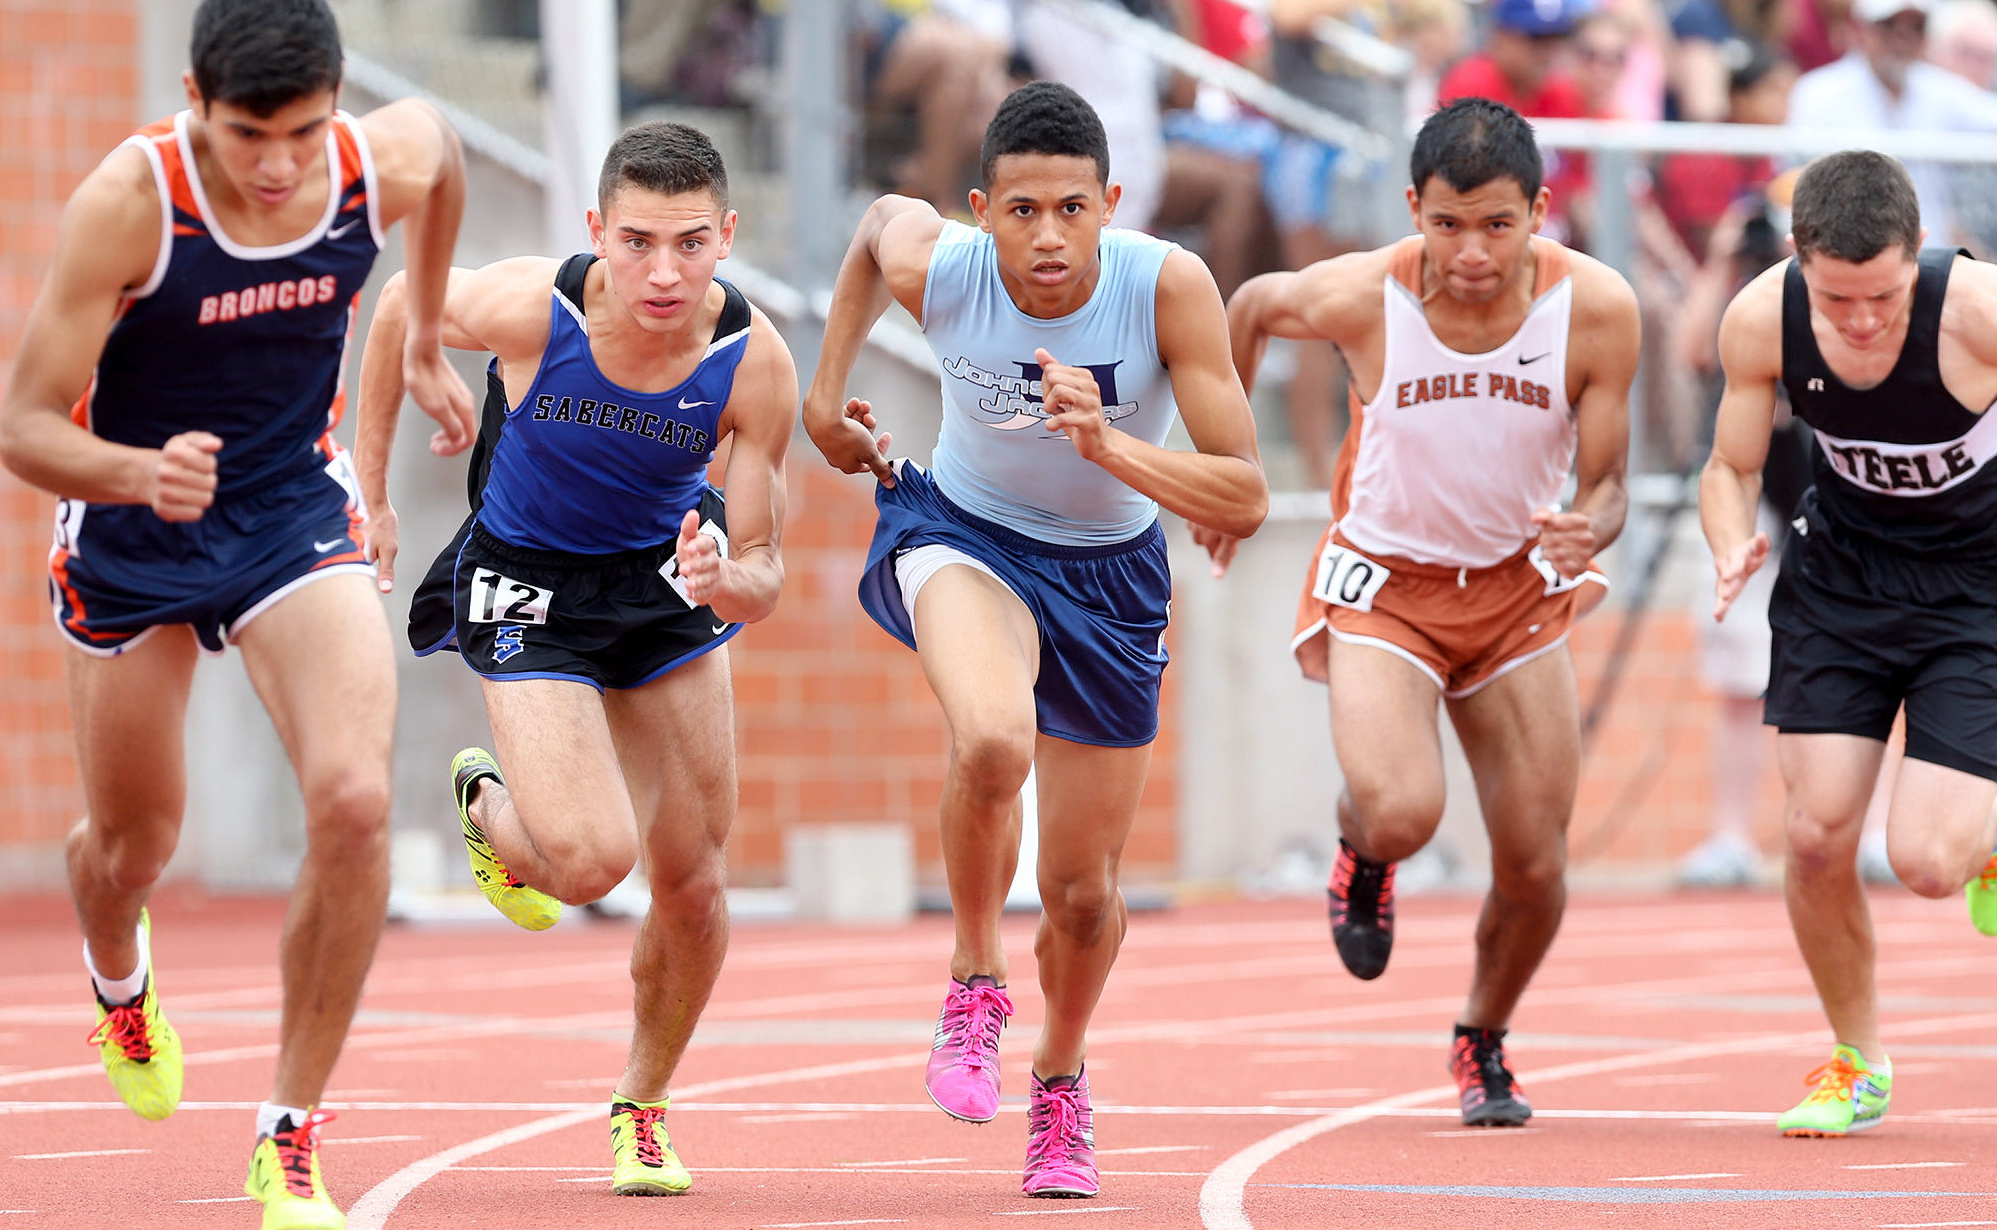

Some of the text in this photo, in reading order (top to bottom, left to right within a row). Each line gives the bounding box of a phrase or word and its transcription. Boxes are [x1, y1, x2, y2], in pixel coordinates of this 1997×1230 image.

[198, 274, 336, 325] BRONCOS
[1397, 372, 1550, 409] EAGLE PASS
[533, 394, 709, 453] SABERCATS
[1828, 442, 1976, 489] TEELE
[479, 573, 540, 621] 12
[1325, 552, 1373, 603] 10
